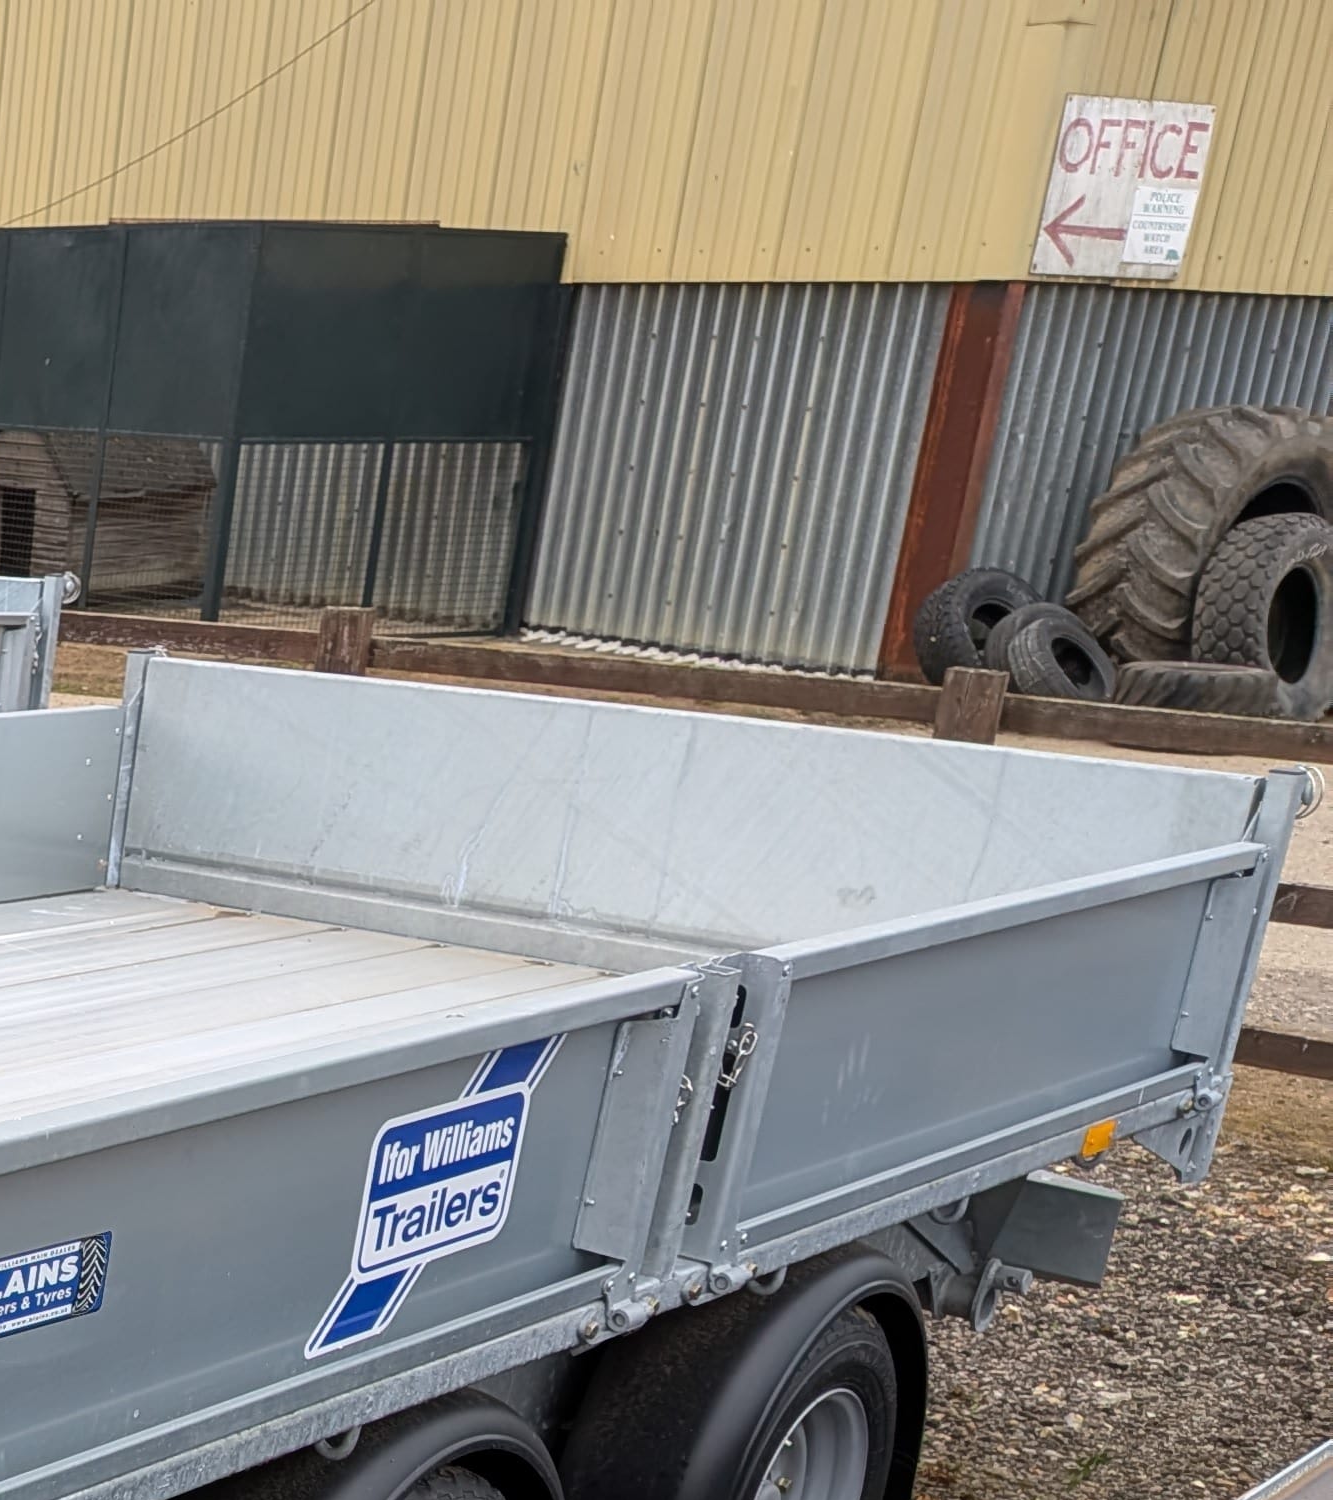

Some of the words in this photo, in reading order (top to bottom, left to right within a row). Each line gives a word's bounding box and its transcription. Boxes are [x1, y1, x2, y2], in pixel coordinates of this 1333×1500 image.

[1059, 117, 1210, 180] OFFICE
[378, 1137, 421, 1186] Ifor
[422, 1116, 516, 1172] Williams
[373, 1180, 501, 1252] Trailers
[30, 1251, 49, 1263] MAIN
[50, 1244, 77, 1257] DEALER
[20, 1295, 31, 1311] &
[35, 1286, 73, 1307] Tyres
